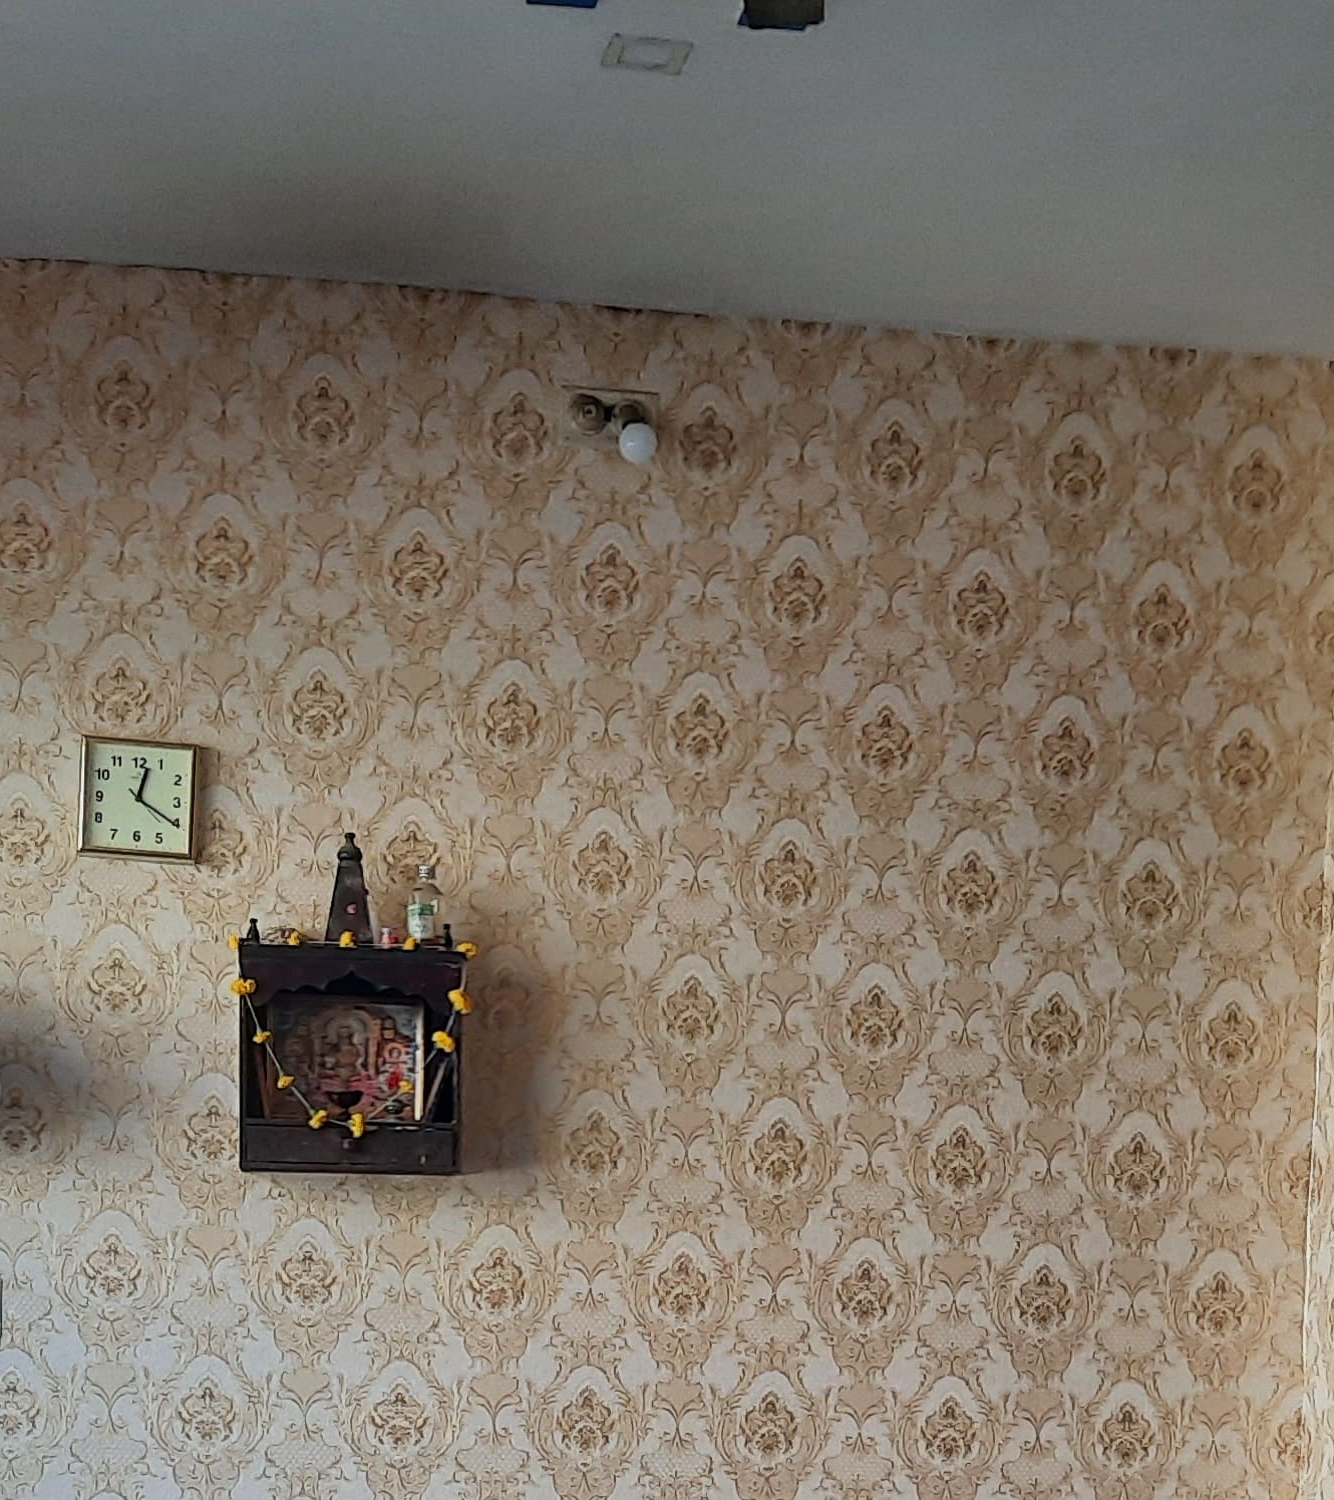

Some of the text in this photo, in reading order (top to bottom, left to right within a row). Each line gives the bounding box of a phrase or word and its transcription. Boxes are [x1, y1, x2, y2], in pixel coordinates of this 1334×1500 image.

[111, 755, 123, 767] 11
[131, 757, 148, 769] 12
[157, 758, 164, 770] 1
[94, 768, 110, 781] 10
[173, 774, 182, 786] 2
[95, 790, 104, 802] 9
[173, 797, 181, 809] 3
[94, 812, 103, 823] 8
[172, 818, 180, 829] 4
[110, 828, 119, 840] 7
[132, 830, 142, 842] 6
[154, 832, 164, 844] 5
